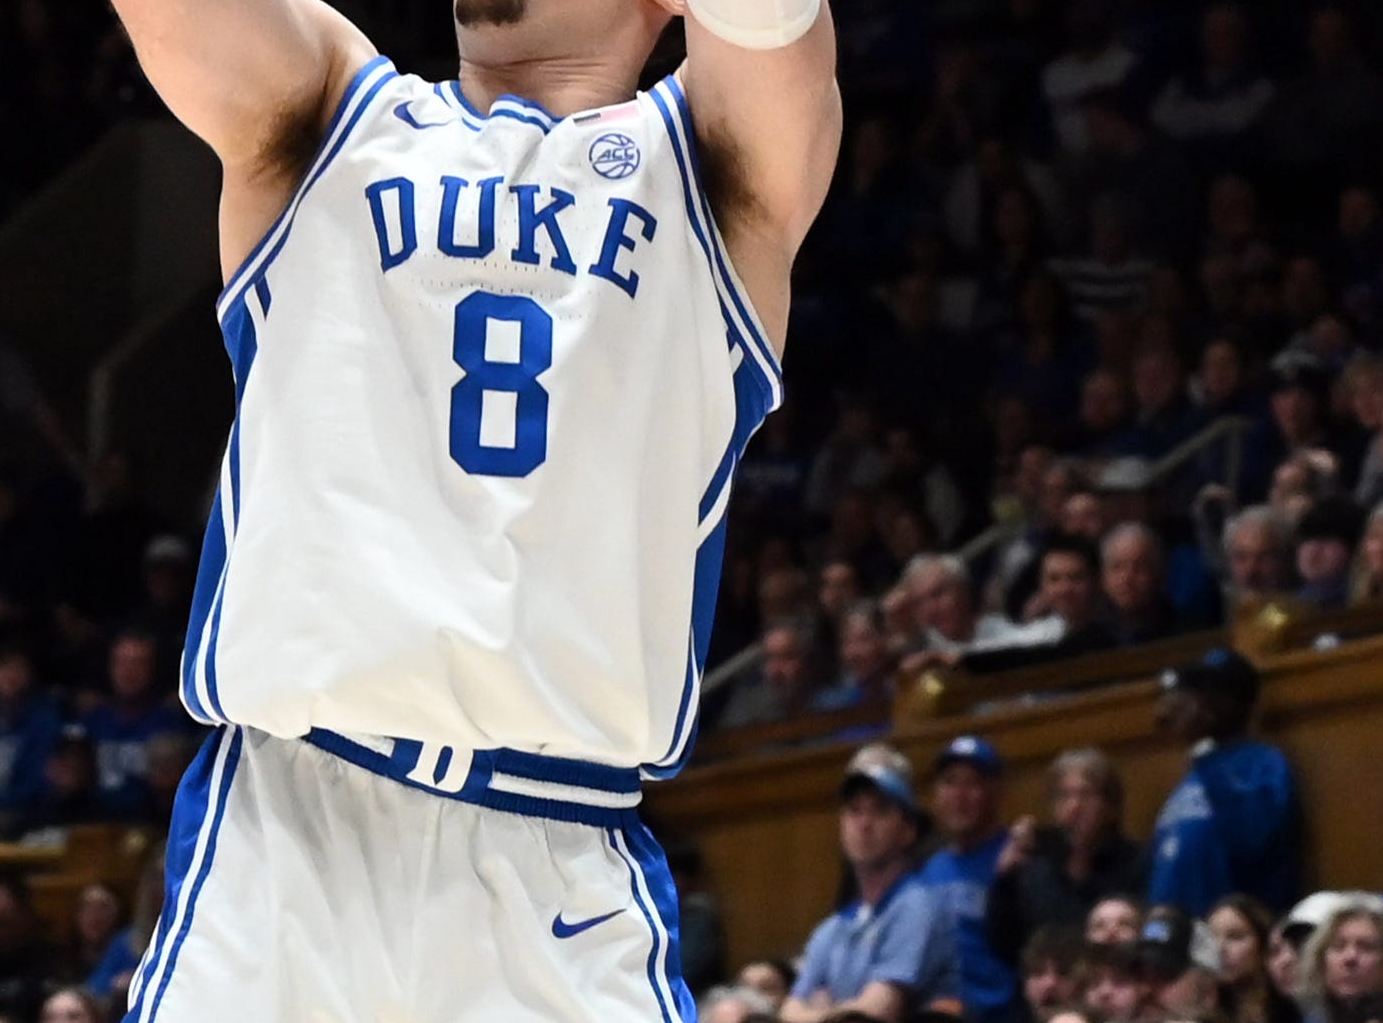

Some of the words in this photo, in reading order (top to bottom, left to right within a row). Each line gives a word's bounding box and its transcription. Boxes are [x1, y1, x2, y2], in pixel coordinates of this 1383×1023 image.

[595, 146, 635, 161] ACC
[365, 176, 658, 299] DUKE
[449, 290, 554, 478] 8
